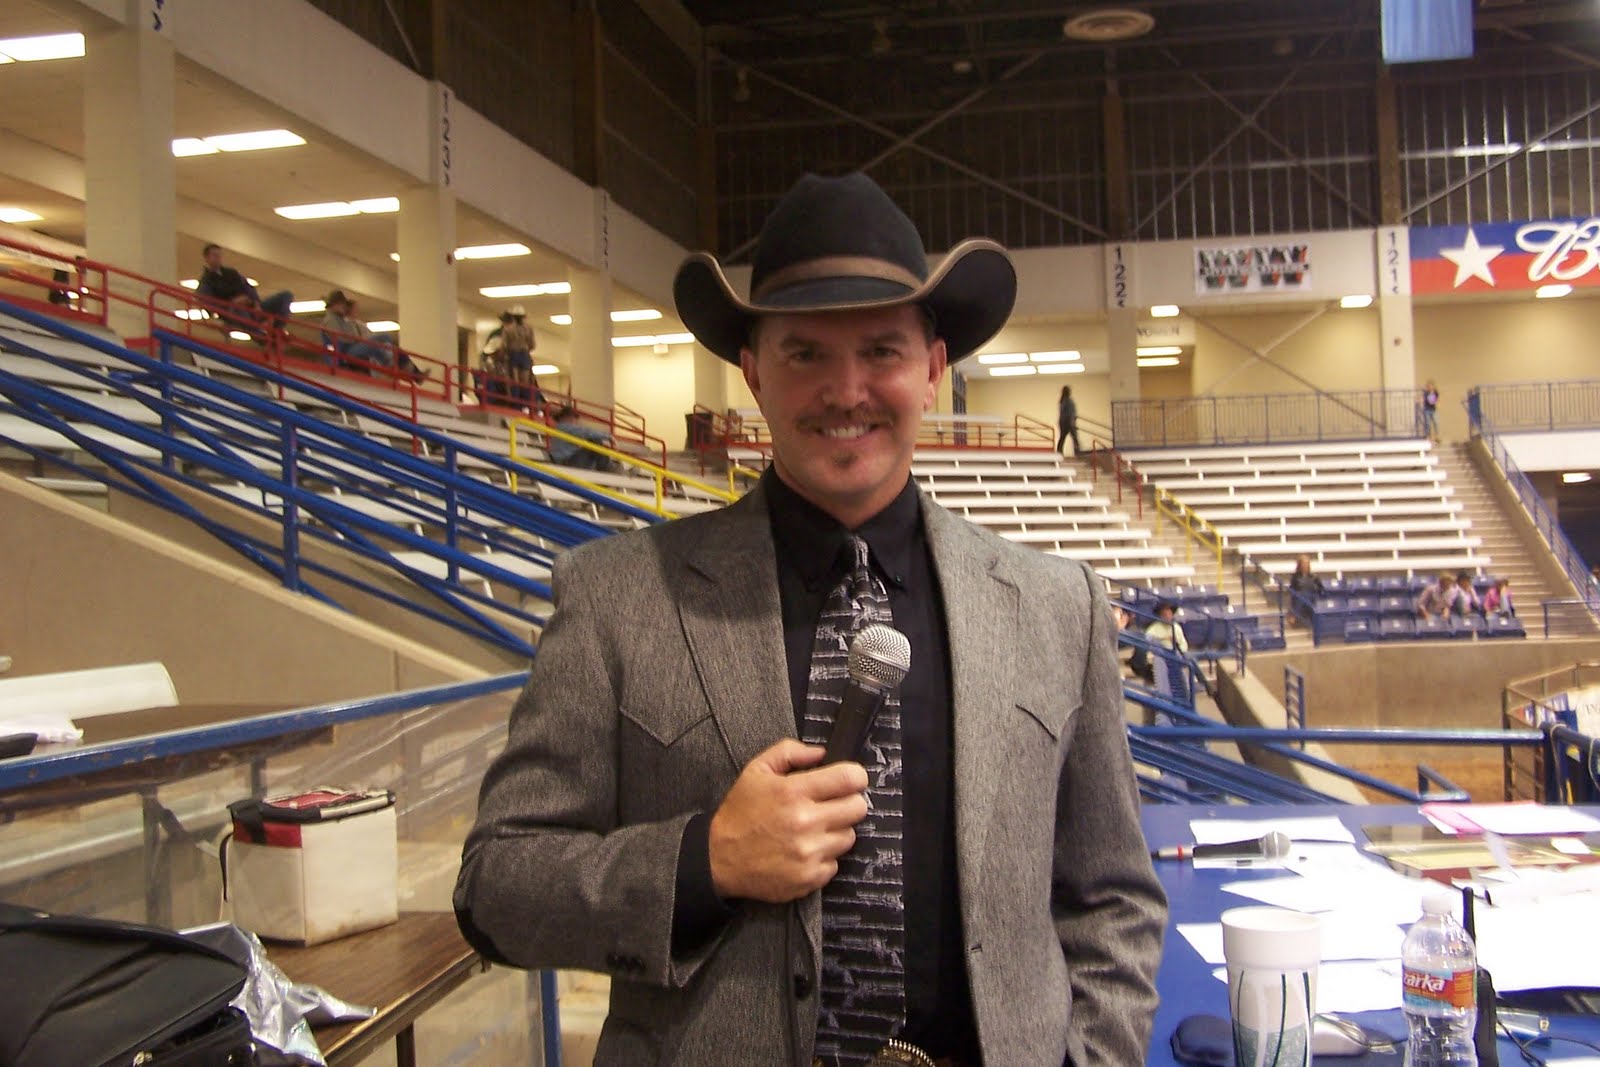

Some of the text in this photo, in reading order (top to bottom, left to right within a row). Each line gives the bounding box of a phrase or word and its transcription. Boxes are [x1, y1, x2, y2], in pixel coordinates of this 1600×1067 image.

[1114, 246, 1127, 299] 122
[1387, 230, 1399, 283] 121
[1515, 218, 1600, 282] B
